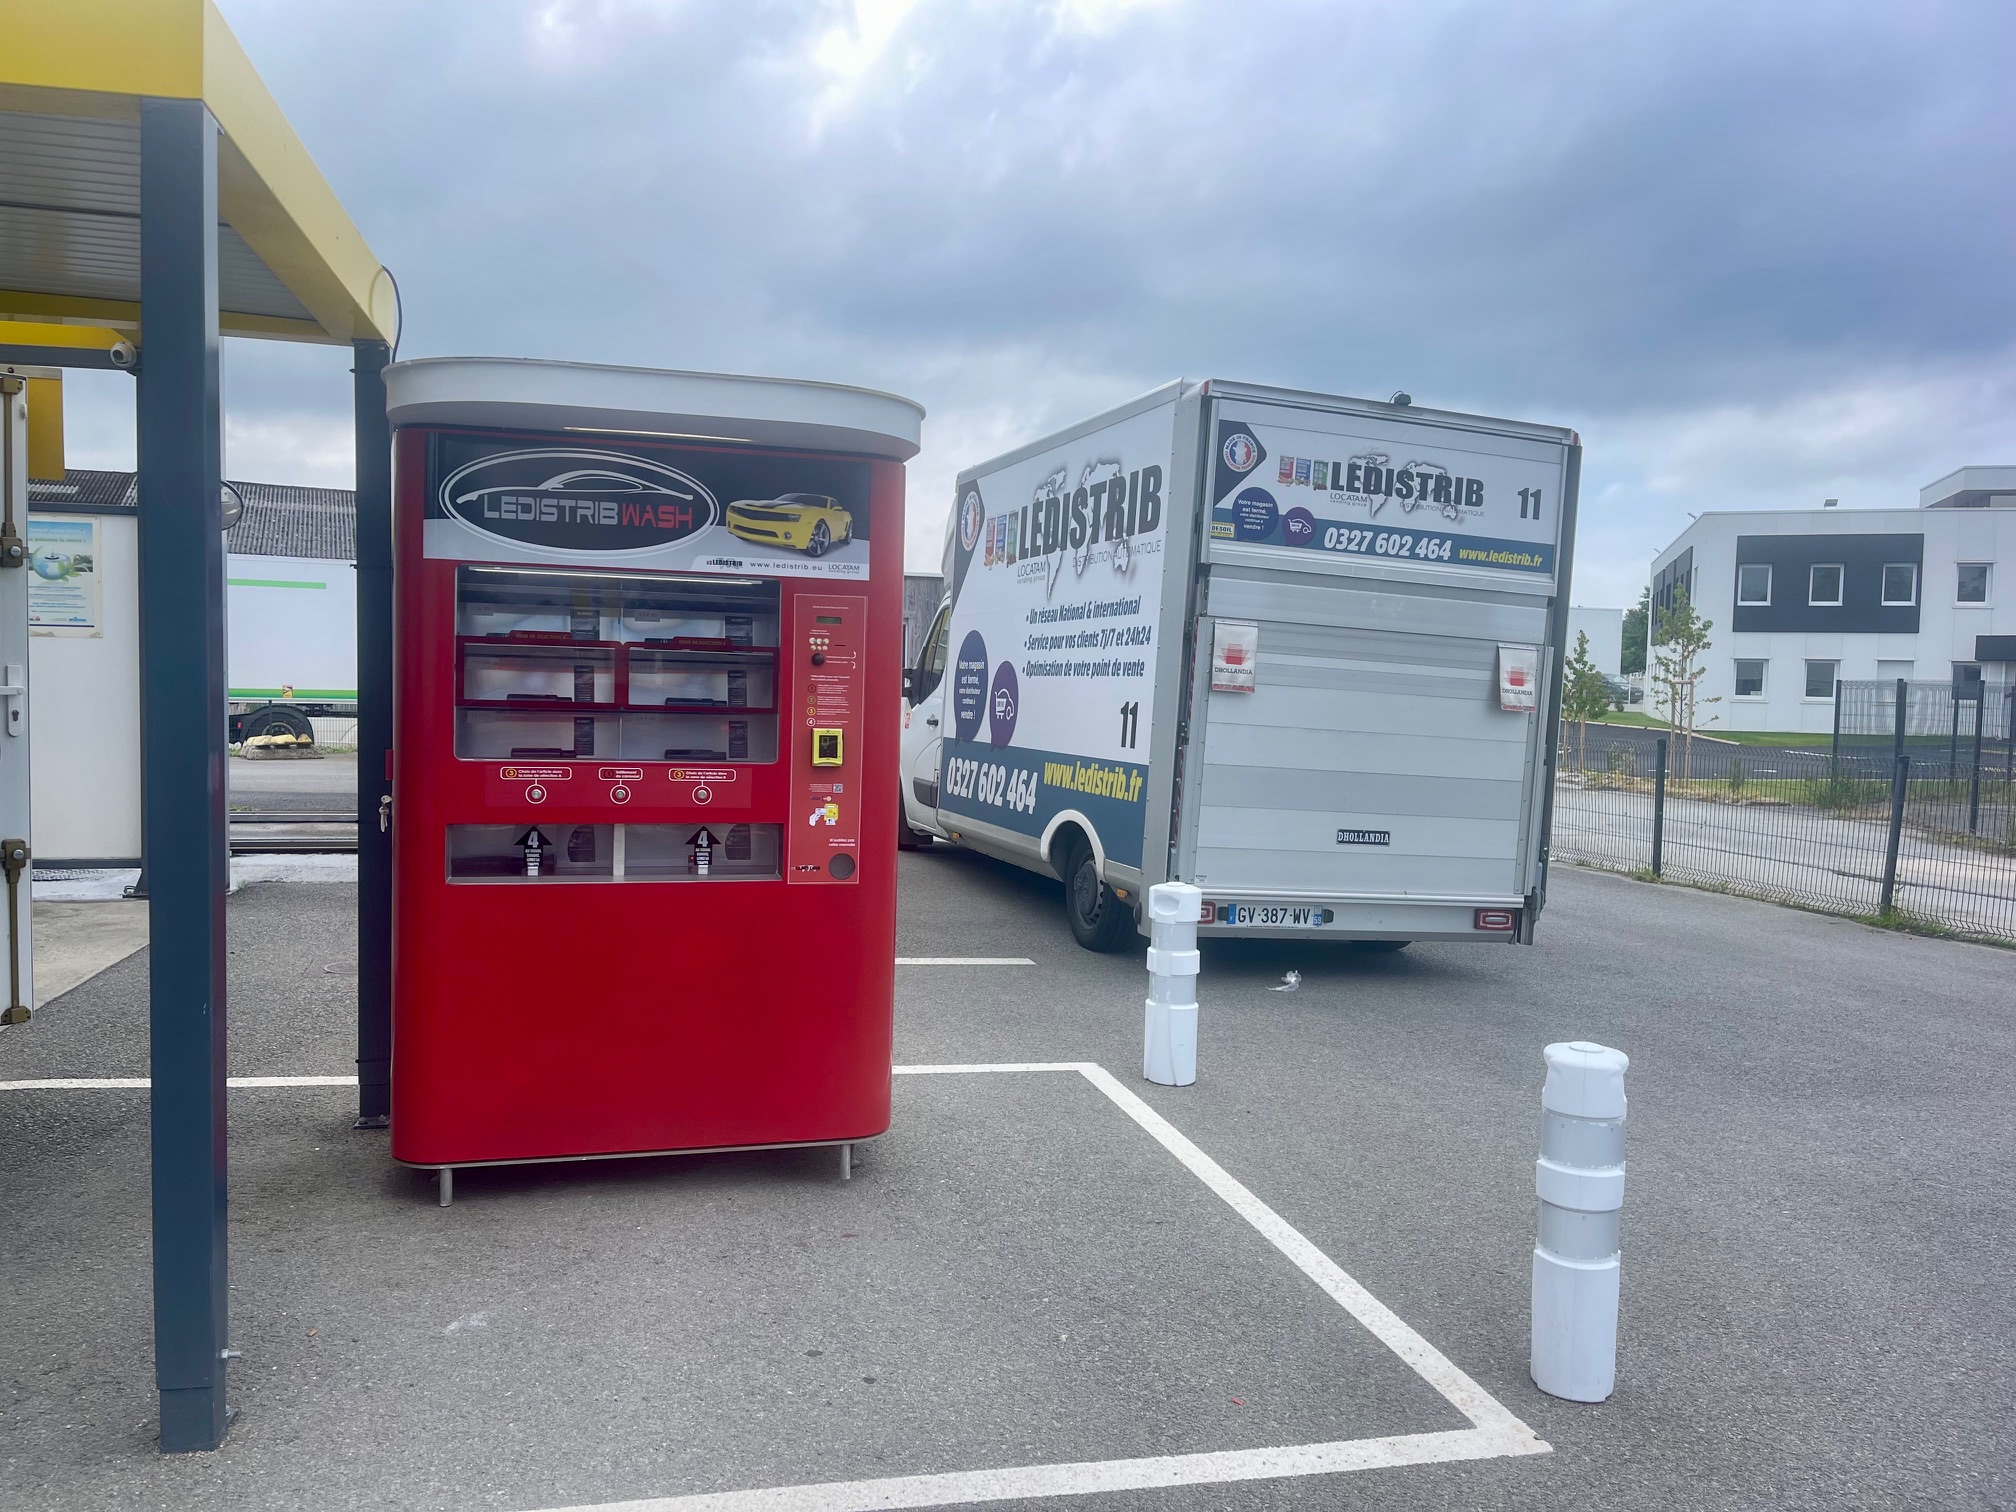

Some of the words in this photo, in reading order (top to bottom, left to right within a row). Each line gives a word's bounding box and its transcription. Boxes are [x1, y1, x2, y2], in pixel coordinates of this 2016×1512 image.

[1330, 461, 1484, 507] LEDISTRIB
[1330, 493, 1368, 503] LOCATAM
[1517, 487, 1542, 520] 11
[621, 504, 693, 530] WASH
[1018, 464, 1163, 561] LEDISTRIB
[1399, 502, 1441, 513] DISTRIBUTION
[1443, 507, 1486, 517] AUTOMATIQUE
[1324, 527, 1374, 552] 0327
[1375, 533, 1412, 557] 602
[1415, 537, 1452, 560] 464
[1072, 550, 1112, 568] DISTRIBUTION
[1113, 540, 1162, 559] AUTOMATIQUE
[1459, 548, 1543, 567] www.ledistrib.fr
[750, 562, 823, 571] www.ledistrib.eu
[1017, 561, 1047, 577] LOCATAM
[1029, 608, 1038, 624] Un
[1038, 607, 1059, 624] réseau
[1059, 602, 1086, 622] National
[1086, 601, 1092, 619] &
[1092, 595, 1141, 619] international
[1027, 634, 1049, 650] Service
[1048, 635, 1064, 651] pour
[1065, 634, 1076, 649] vos
[1077, 630, 1099, 648] clients
[1100, 628, 1116, 650] 7j/7
[1116, 628, 1124, 646] et
[1124, 625, 1152, 646] 24h24
[1026, 660, 1063, 678] Optimisation
[1063, 659, 1072, 676] de
[1073, 660, 1091, 676] votre
[1091, 659, 1111, 679] point
[1111, 658, 1121, 677] de
[1122, 659, 1145, 677] vente
[1214, 667, 1253, 675] DHOLLANDIA
[1502, 688, 1534, 696] DHOLLANDIA
[1120, 701, 1139, 749] 11
[947, 757, 978, 799] 0327
[978, 763, 1006, 807] 602
[1006, 768, 1038, 814] 464
[1044, 761, 1142, 803] www.ledistrib.fr
[528, 831, 539, 848] 4
[697, 830, 709, 847] 4
[1338, 832, 1389, 843] DHOLLANDIA
[1238, 907, 1311, 924] GV-387-WV
[1313, 915, 1322, 924] 59
